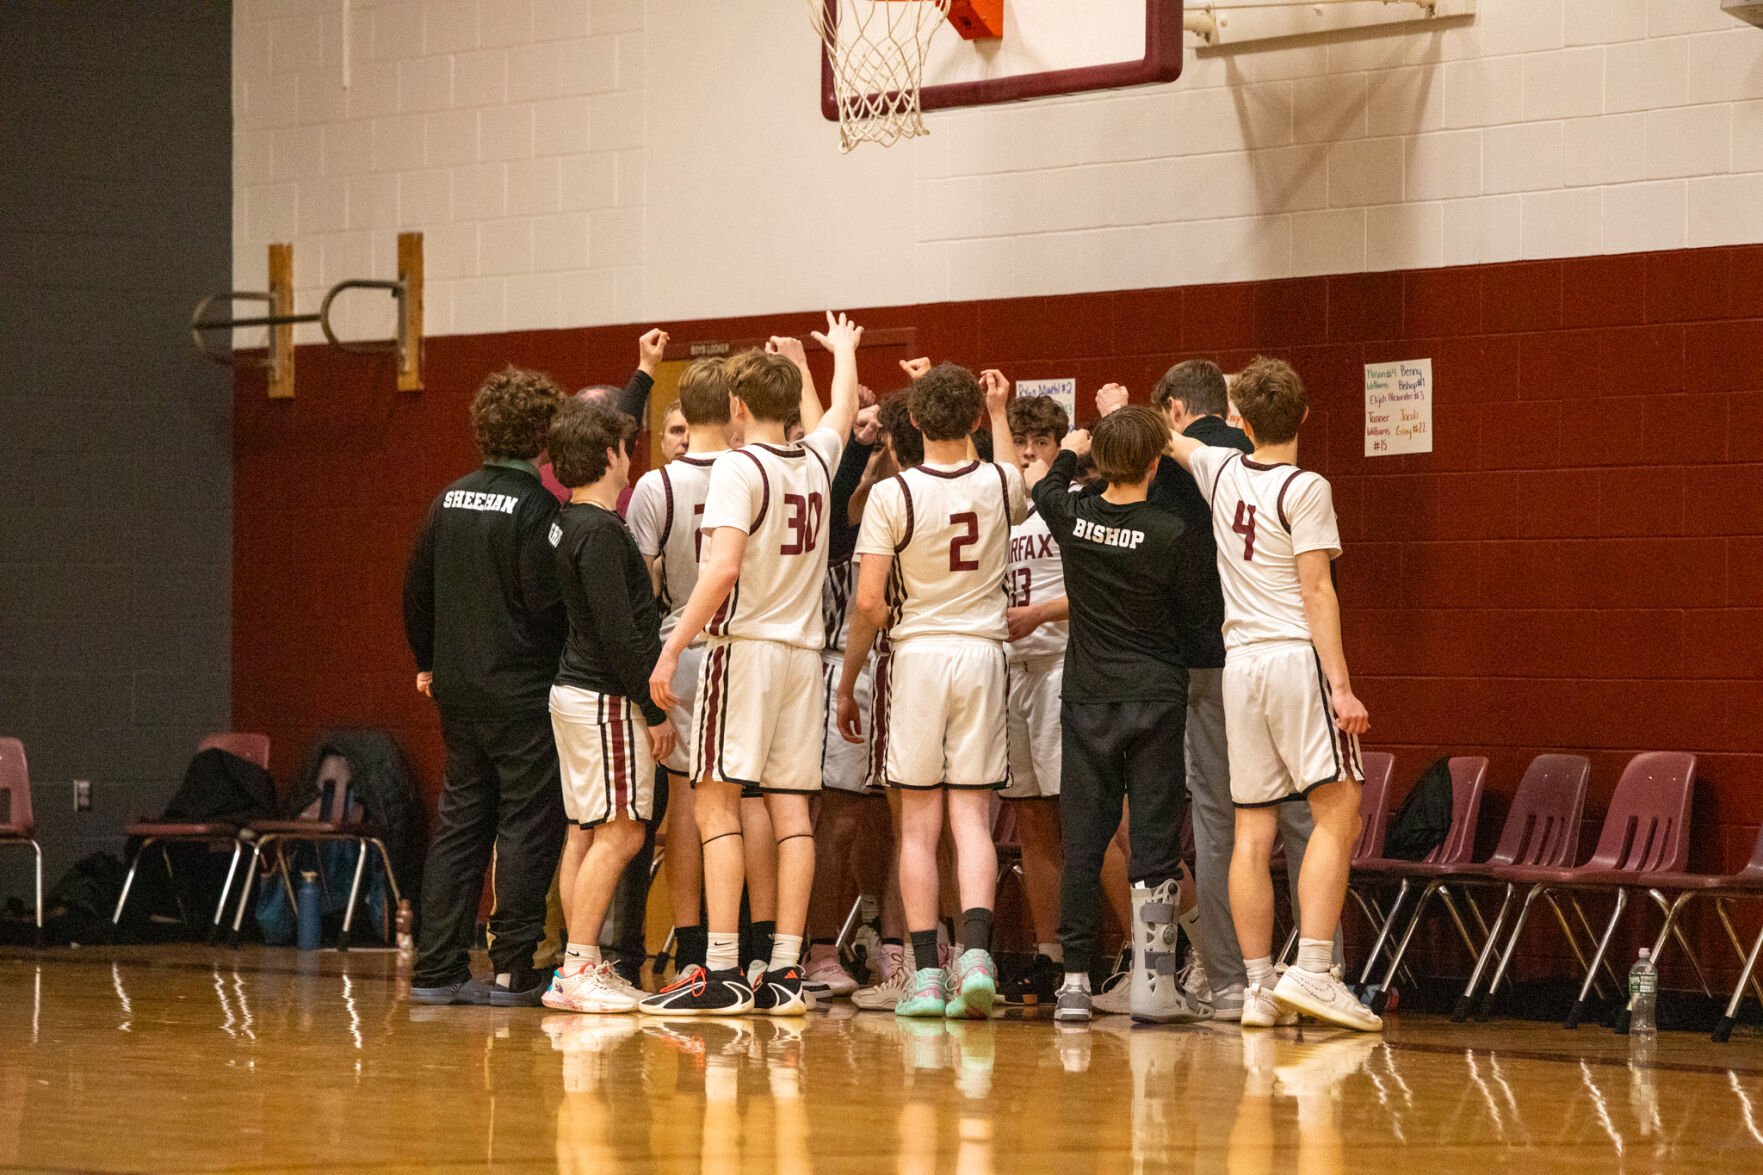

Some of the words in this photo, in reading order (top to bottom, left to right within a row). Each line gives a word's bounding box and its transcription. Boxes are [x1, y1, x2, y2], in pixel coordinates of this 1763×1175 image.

[443, 490, 518, 514] SHEEHAN
[780, 491, 822, 556] 30
[949, 511, 979, 572] 2
[1072, 518, 1145, 550] BISHOP
[1232, 500, 1256, 561] 4
[1008, 533, 1054, 564] RFAX
[1011, 568, 1031, 607] 13
